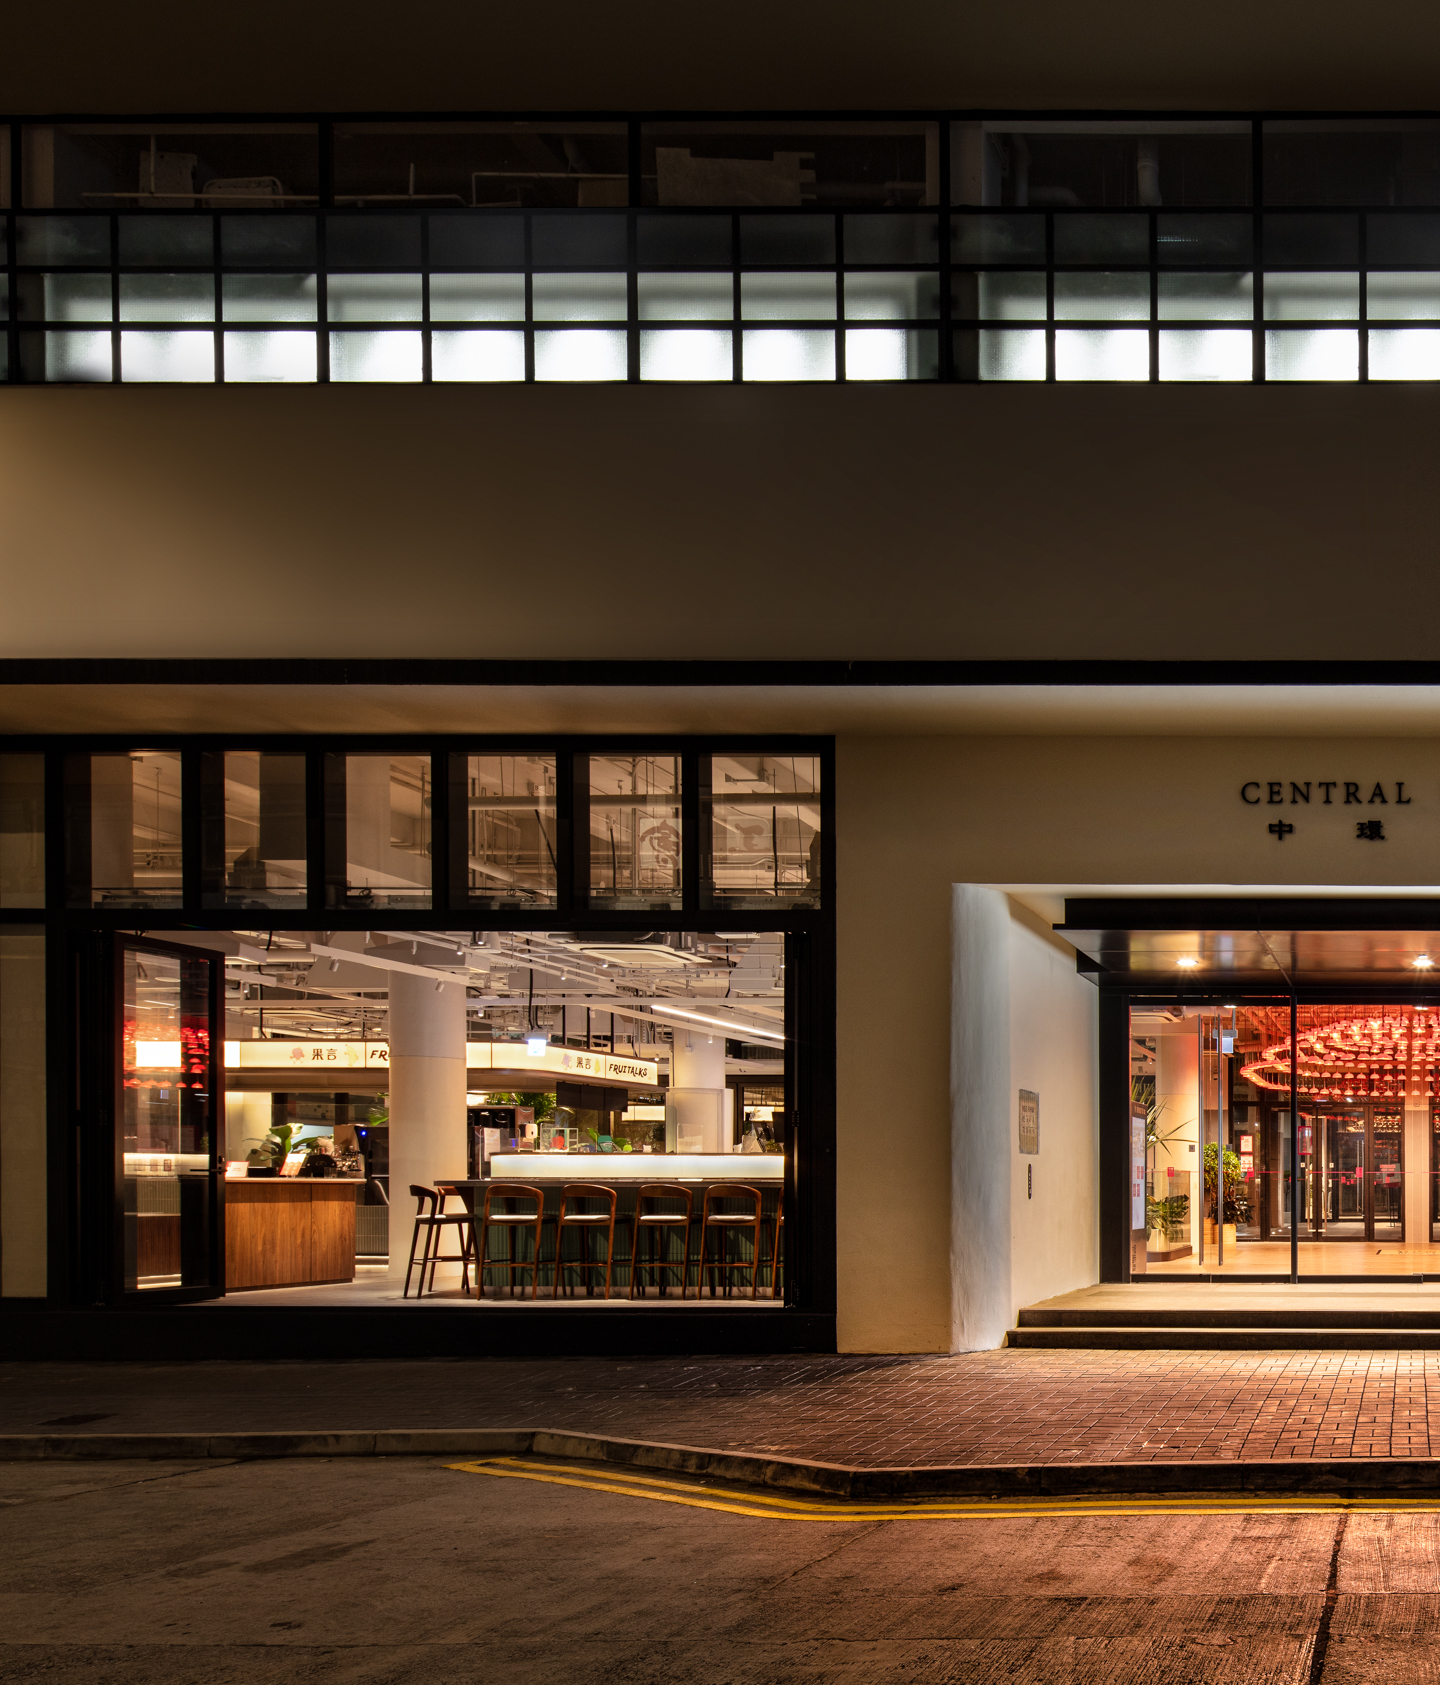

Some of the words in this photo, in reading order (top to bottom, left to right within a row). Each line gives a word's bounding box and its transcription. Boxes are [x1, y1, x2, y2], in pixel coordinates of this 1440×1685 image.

[1240, 781, 1412, 804] CENTRAL
[311, 1048, 338, 1061] 果言
[369, 1049, 389, 1062] FR
[608, 1063, 648, 1078] FRUITALKS
